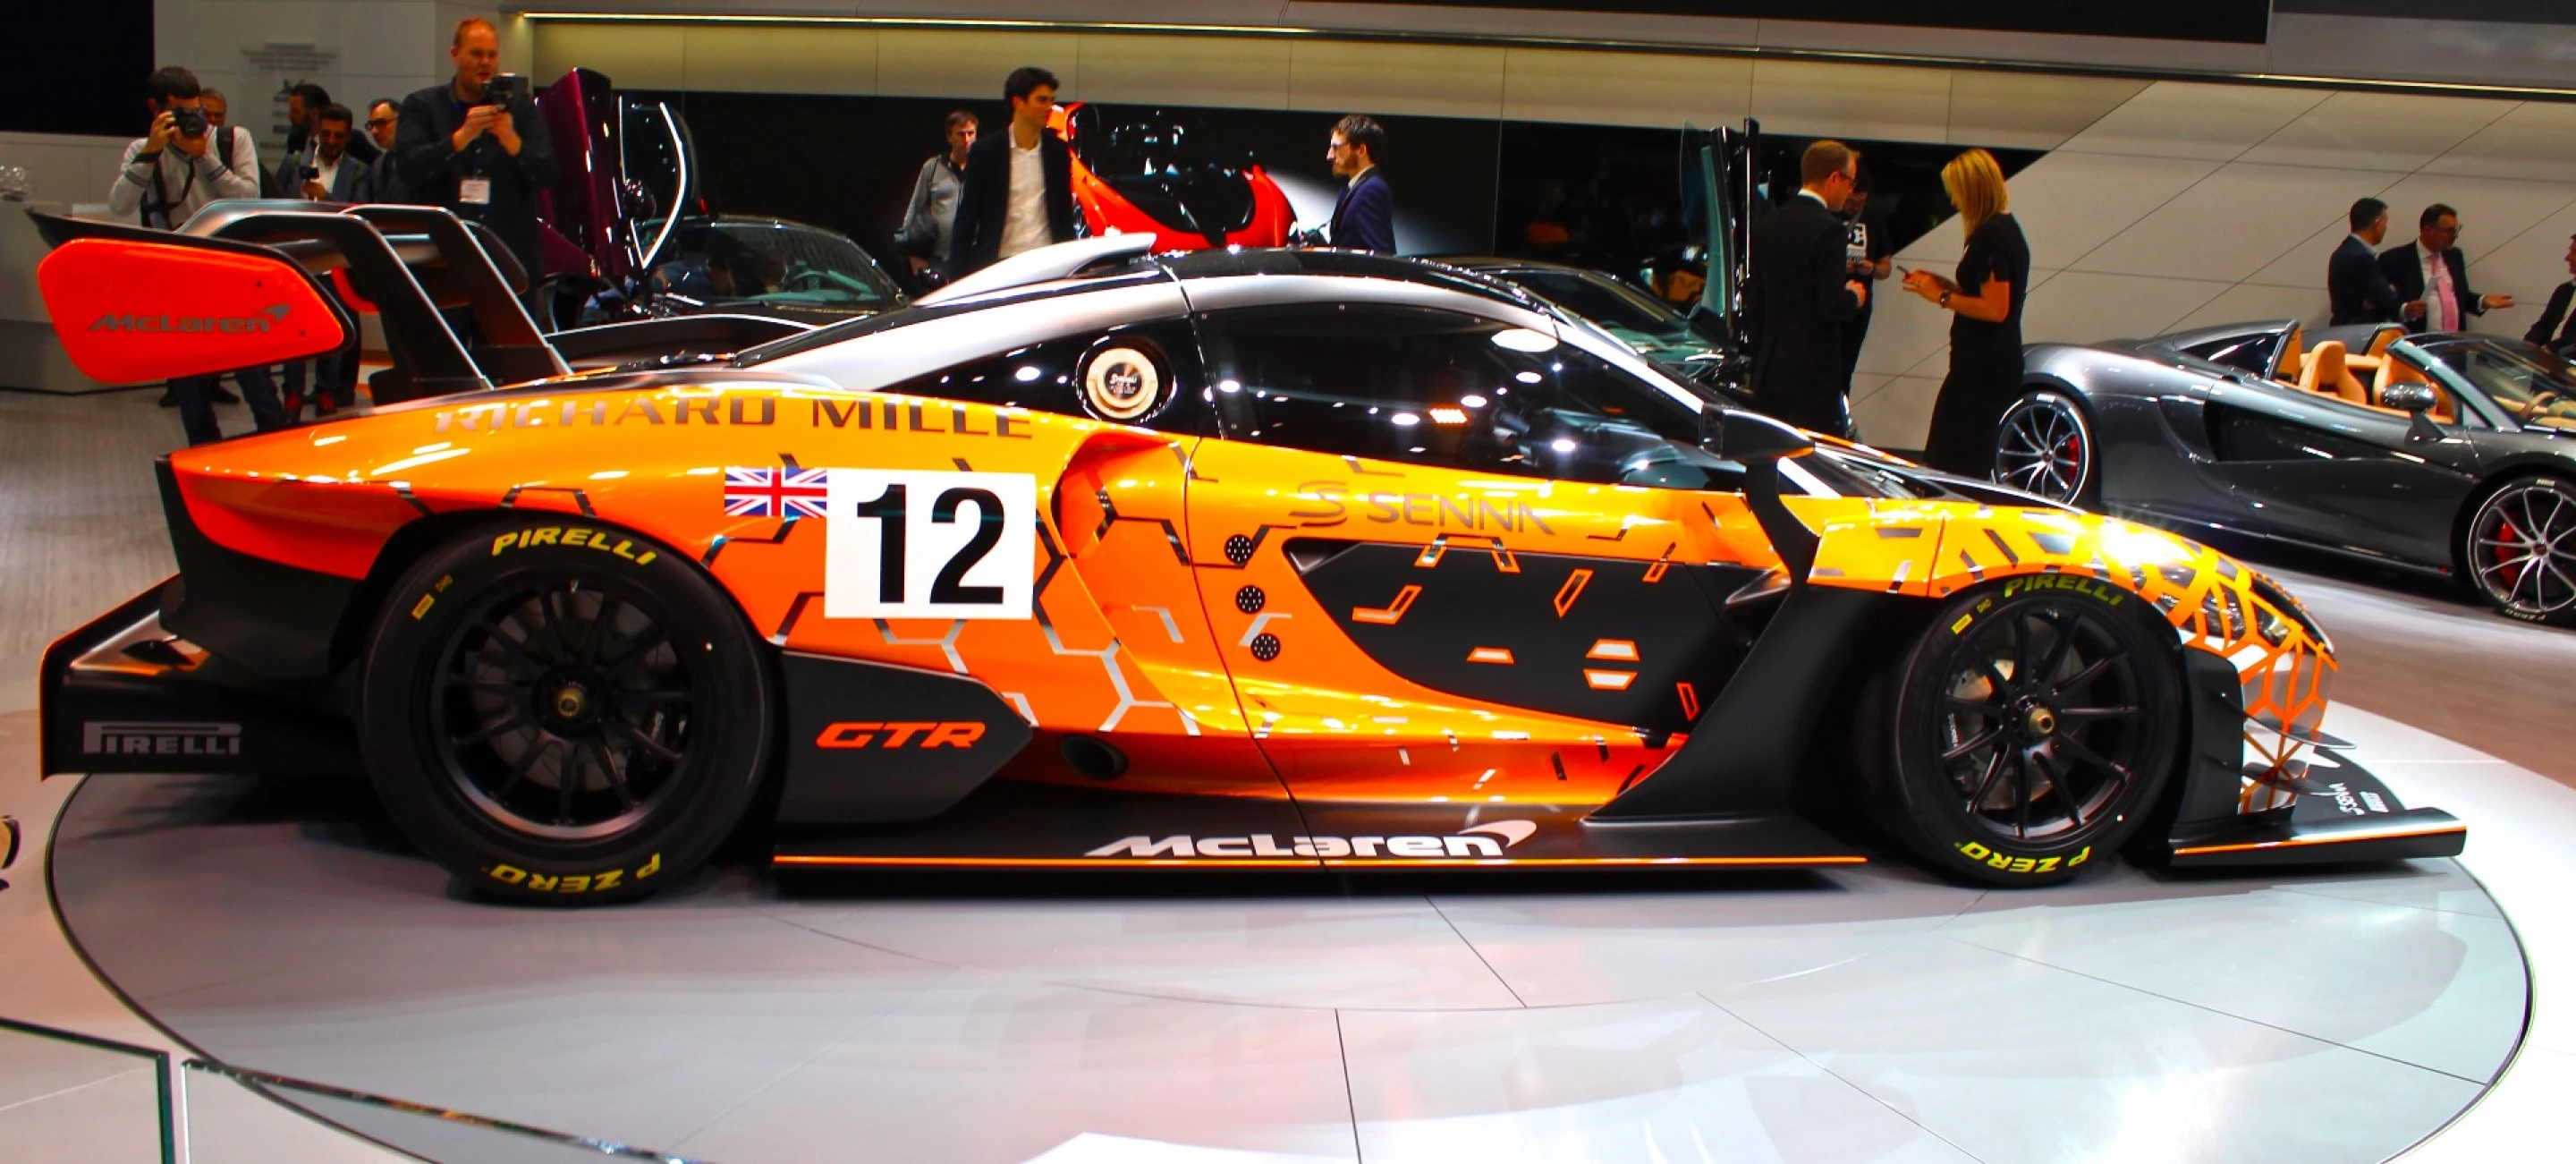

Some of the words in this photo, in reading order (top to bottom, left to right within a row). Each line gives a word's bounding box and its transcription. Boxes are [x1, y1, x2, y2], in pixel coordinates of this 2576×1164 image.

[88, 313, 270, 334] McLaren
[434, 395, 775, 433] RICHARD
[812, 398, 1032, 438] MILLE
[1367, 490, 1555, 536] SENNA
[492, 527, 657, 565] PIRELLI
[857, 483, 1004, 605] 12
[2004, 573, 2123, 607] PIRELLI
[83, 721, 242, 755] PIRELLI
[815, 722, 986, 749] GTR
[1084, 833, 1504, 858] McLaren
[1960, 841, 2062, 873] ZERO
[2068, 845, 2091, 867] P
[490, 863, 624, 894] ZERO
[636, 853, 660, 879] P
